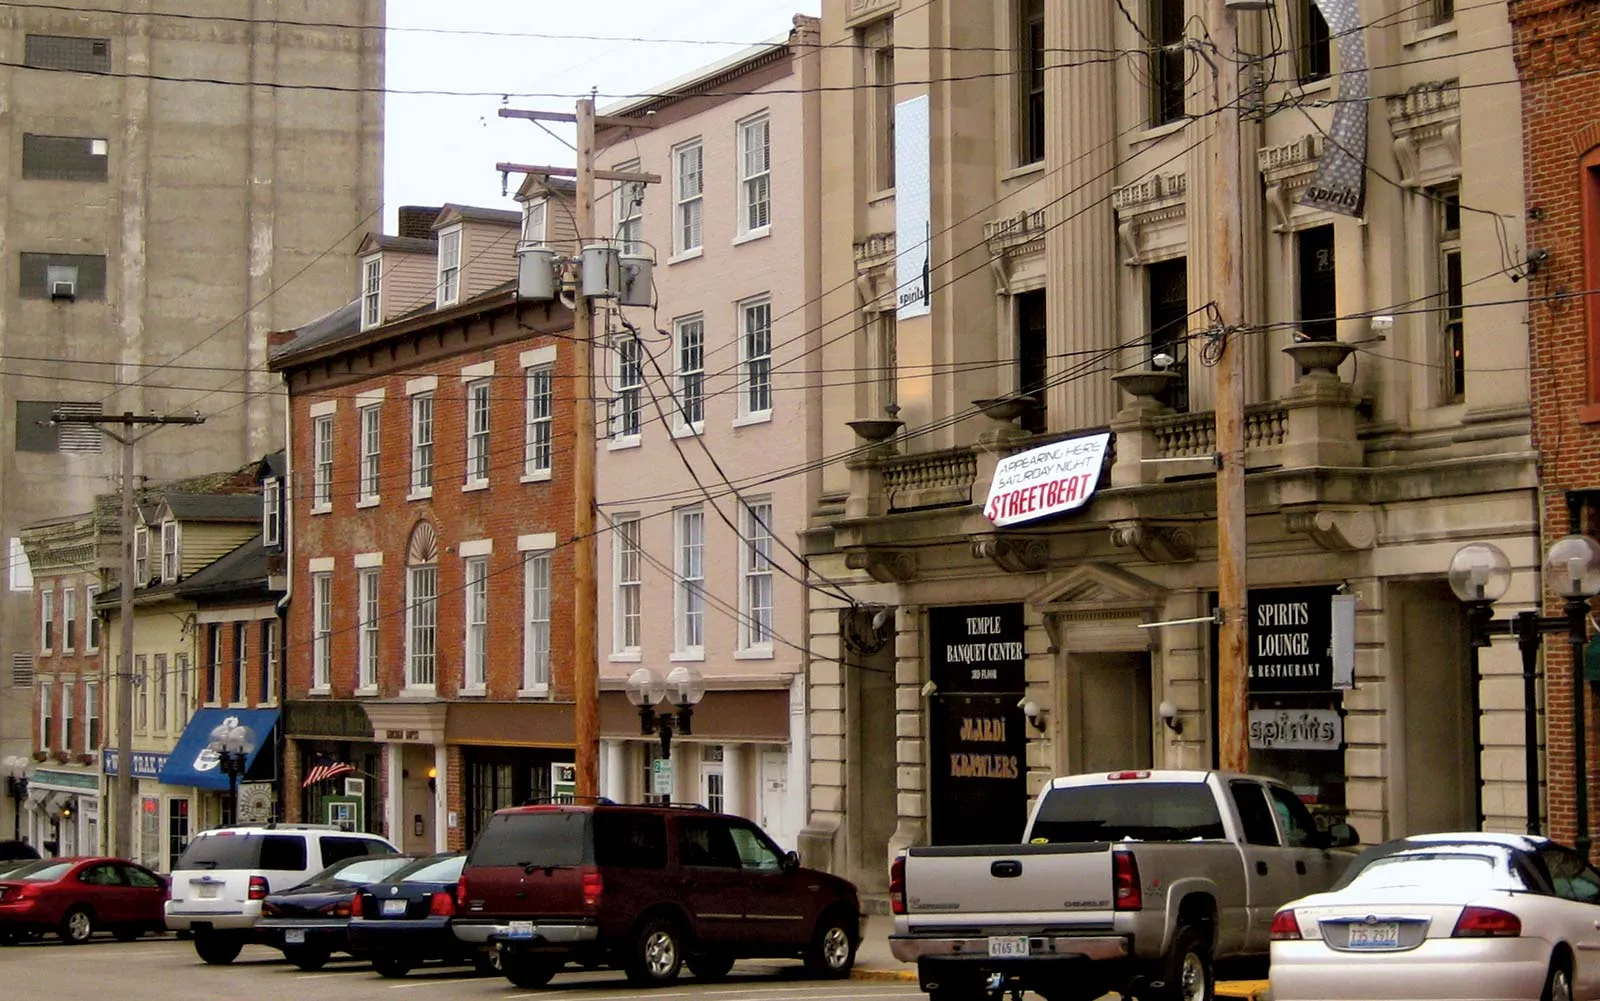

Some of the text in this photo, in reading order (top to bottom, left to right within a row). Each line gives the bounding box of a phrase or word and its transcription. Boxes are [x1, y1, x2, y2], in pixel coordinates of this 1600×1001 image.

[1307, 183, 1357, 207] spirits
[900, 286, 924, 306] spirits
[999, 441, 1101, 476] APPEARING HERE
[998, 456, 1094, 489] SATURDAY NIGHT
[987, 472, 1092, 521] STREETBEAT
[966, 615, 1002, 636] TEMPLE
[1257, 602, 1309, 627] SPIRITS
[946, 642, 1023, 665] BANQUET CENTER
[1258, 632, 1310, 657] LOUNGE
[1258, 663, 1320, 677] RESTAURANT
[1250, 713, 1335, 746] spirits
[950, 753, 1018, 779] KRAWLERS
